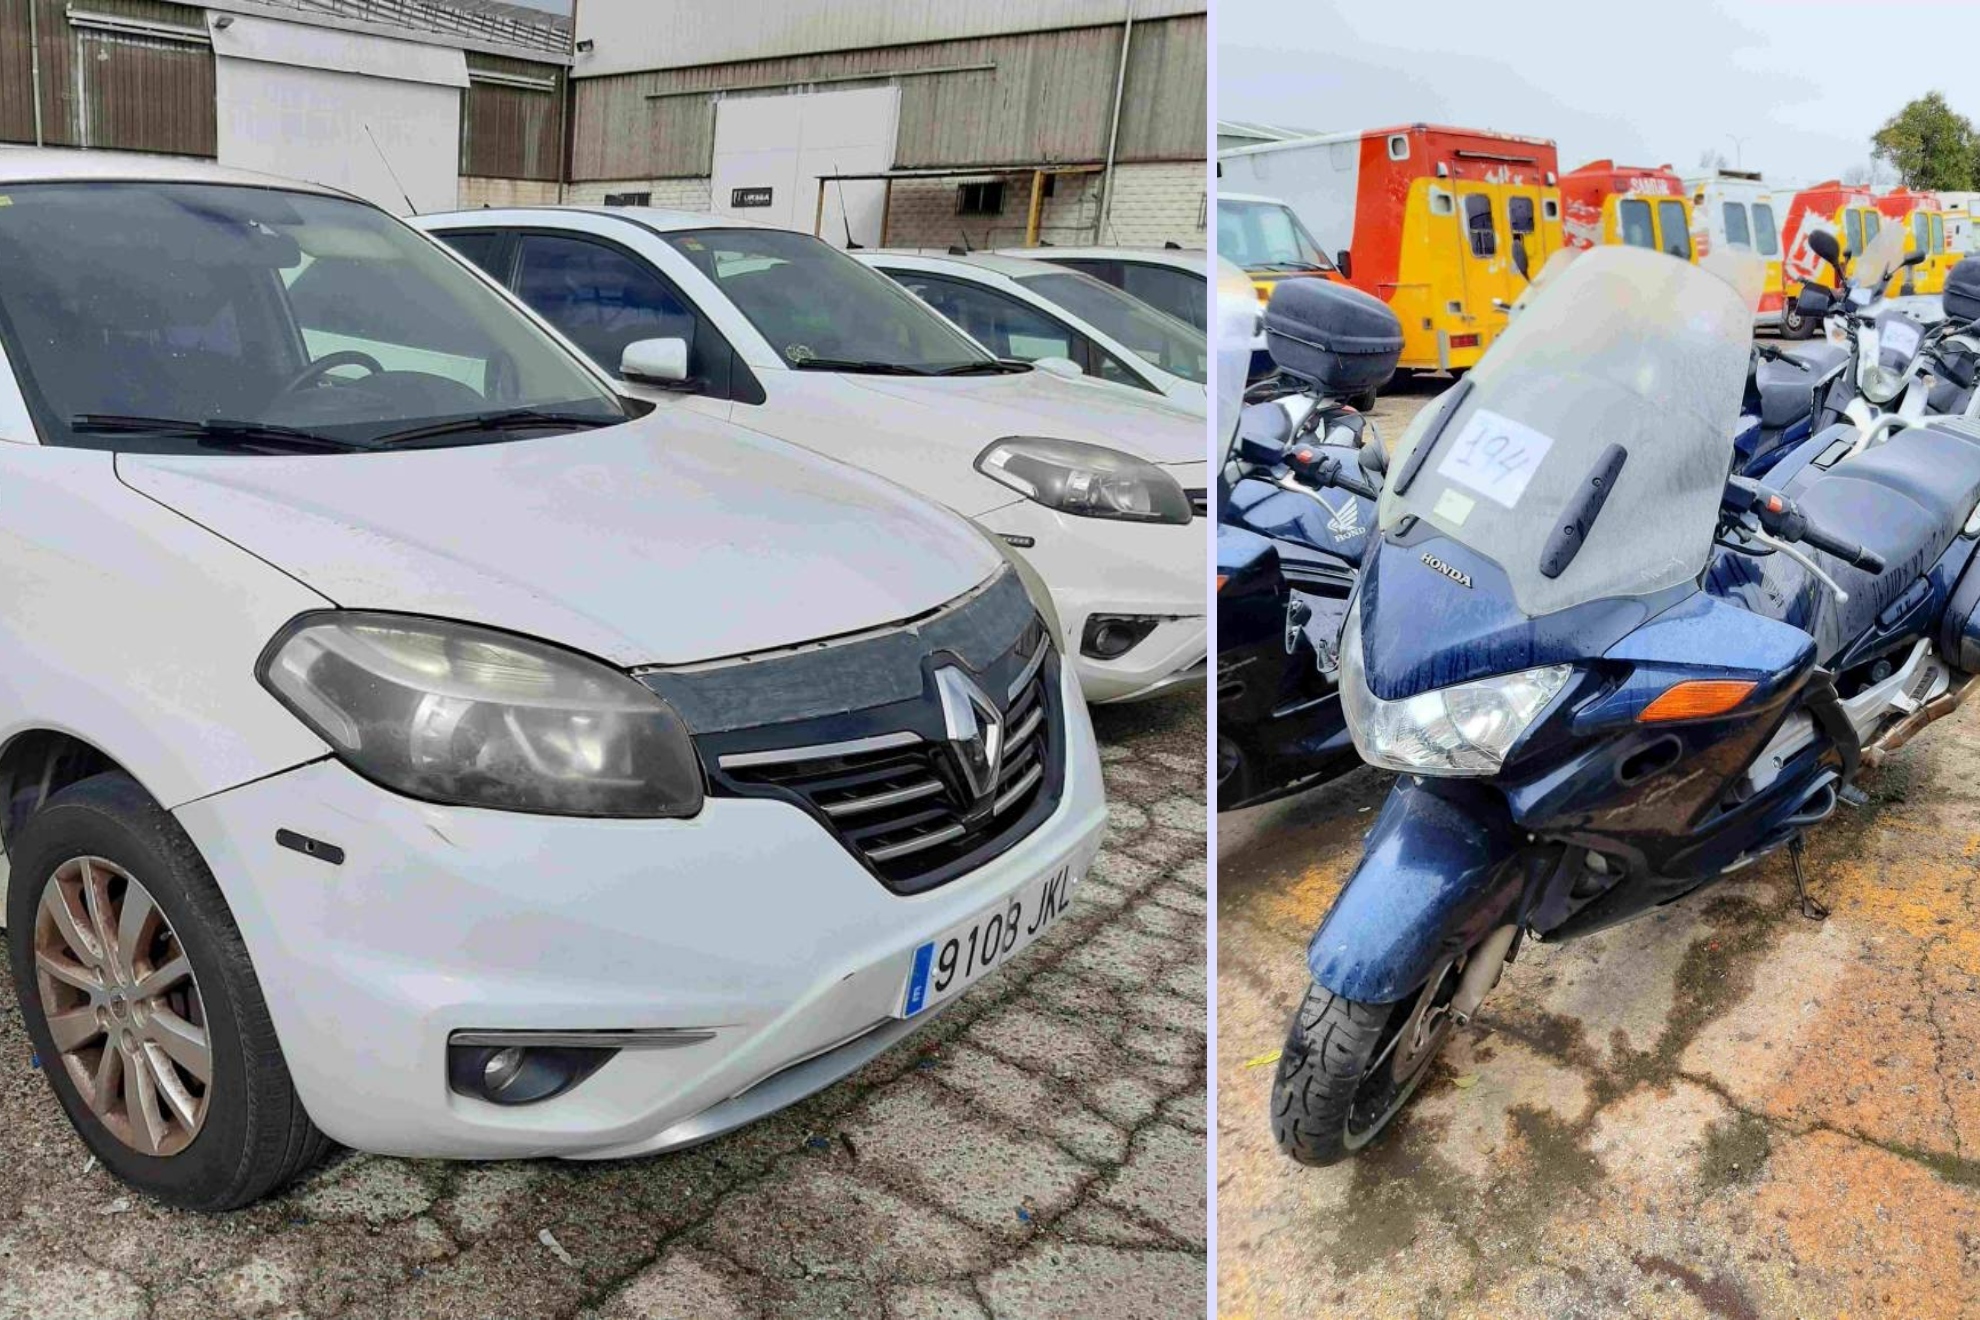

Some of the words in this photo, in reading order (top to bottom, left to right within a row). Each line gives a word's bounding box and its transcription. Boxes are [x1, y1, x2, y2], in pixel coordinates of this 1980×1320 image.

[1456, 428, 1530, 485] 194
[1334, 527, 1367, 542] HOND
[1421, 552, 1472, 588] HONDA
[934, 902, 1022, 992] 9108
[1027, 865, 1070, 935] JKL
